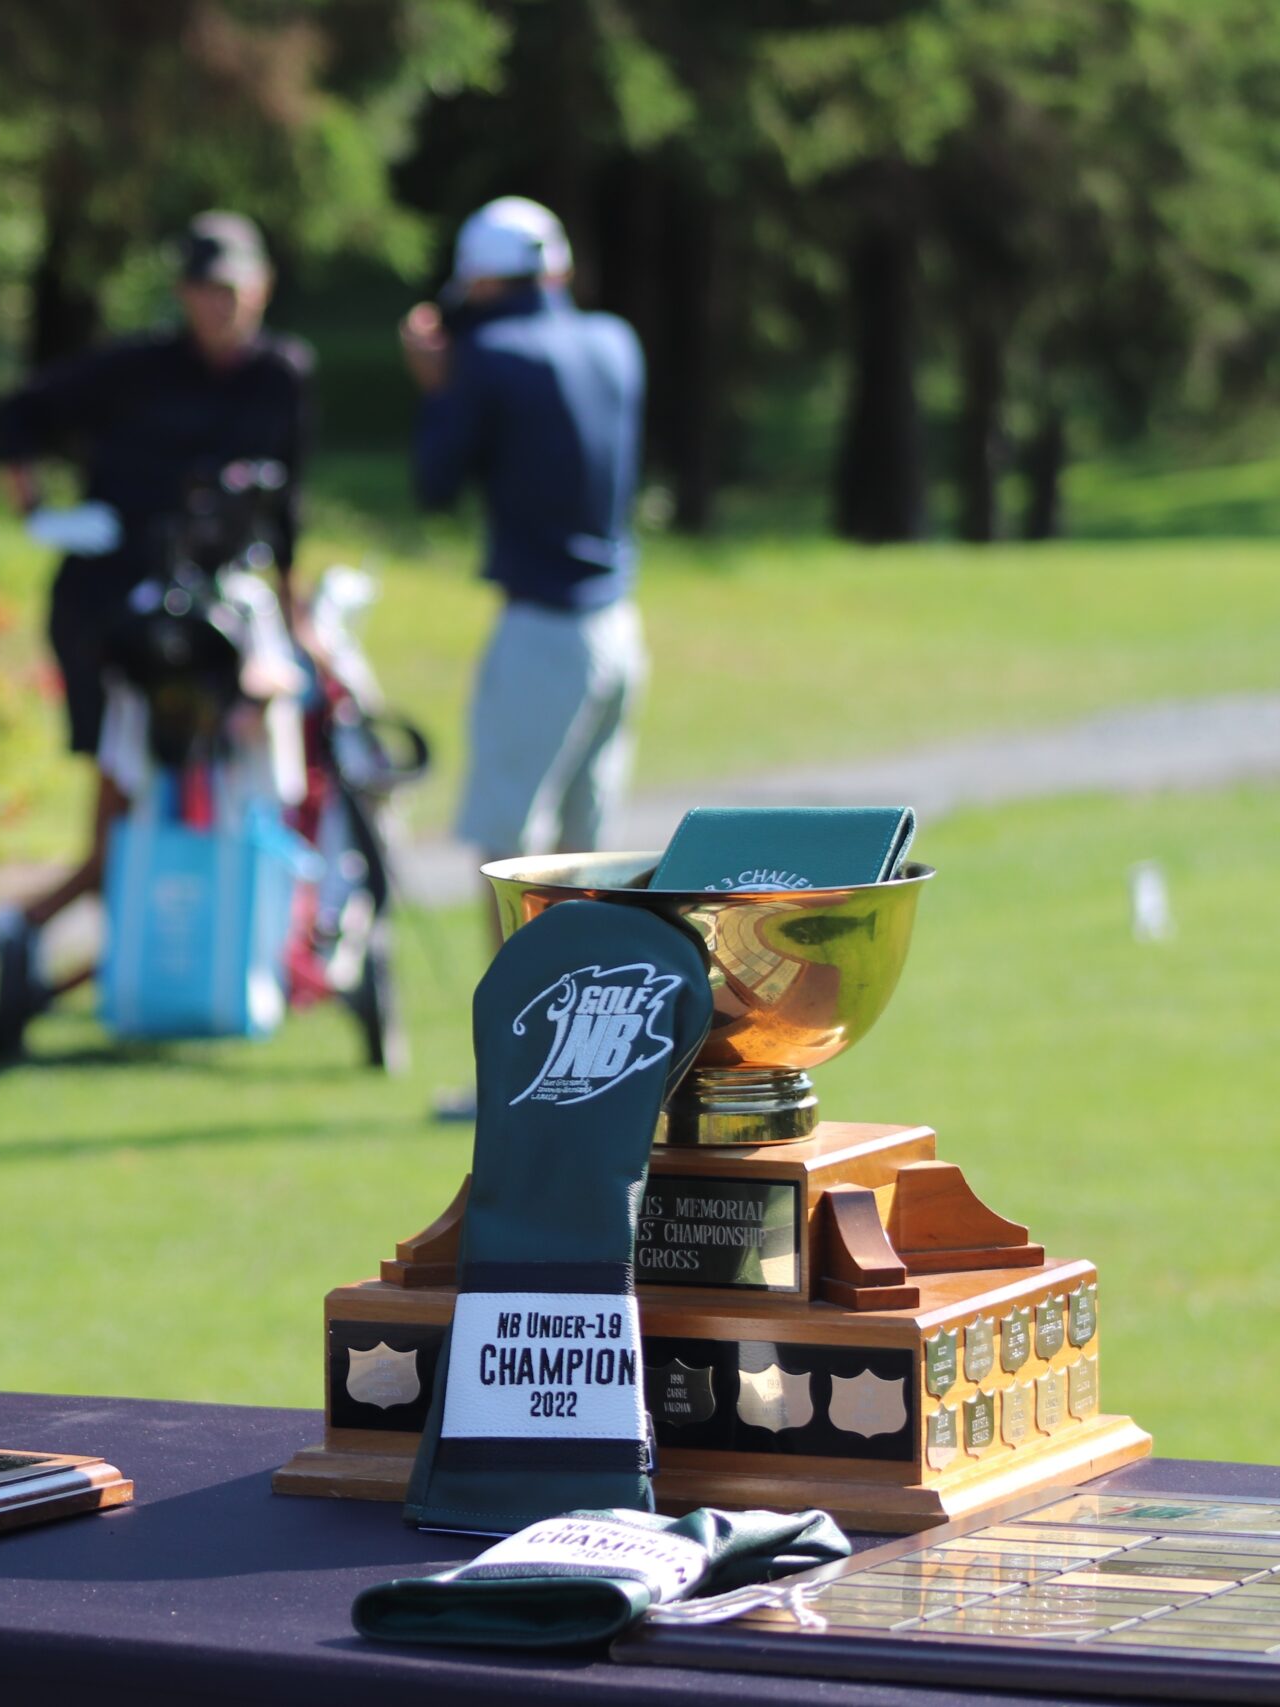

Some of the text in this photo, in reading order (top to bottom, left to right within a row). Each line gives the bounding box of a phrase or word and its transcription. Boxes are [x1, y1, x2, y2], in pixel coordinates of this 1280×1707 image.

[738, 868, 813, 888] CHALLE
[575, 985, 653, 1015] GOLF
[547, 1014, 644, 1078] NB
[638, 1195, 764, 1221] IS MEMORIAL
[664, 1222, 767, 1248] CHAMPIONSHIP
[639, 1247, 700, 1270] GROSS
[497, 1312, 622, 1339] NB UNDER-19
[480, 1344, 637, 1386] CHAMPION
[530, 1391, 578, 1418] 2022
